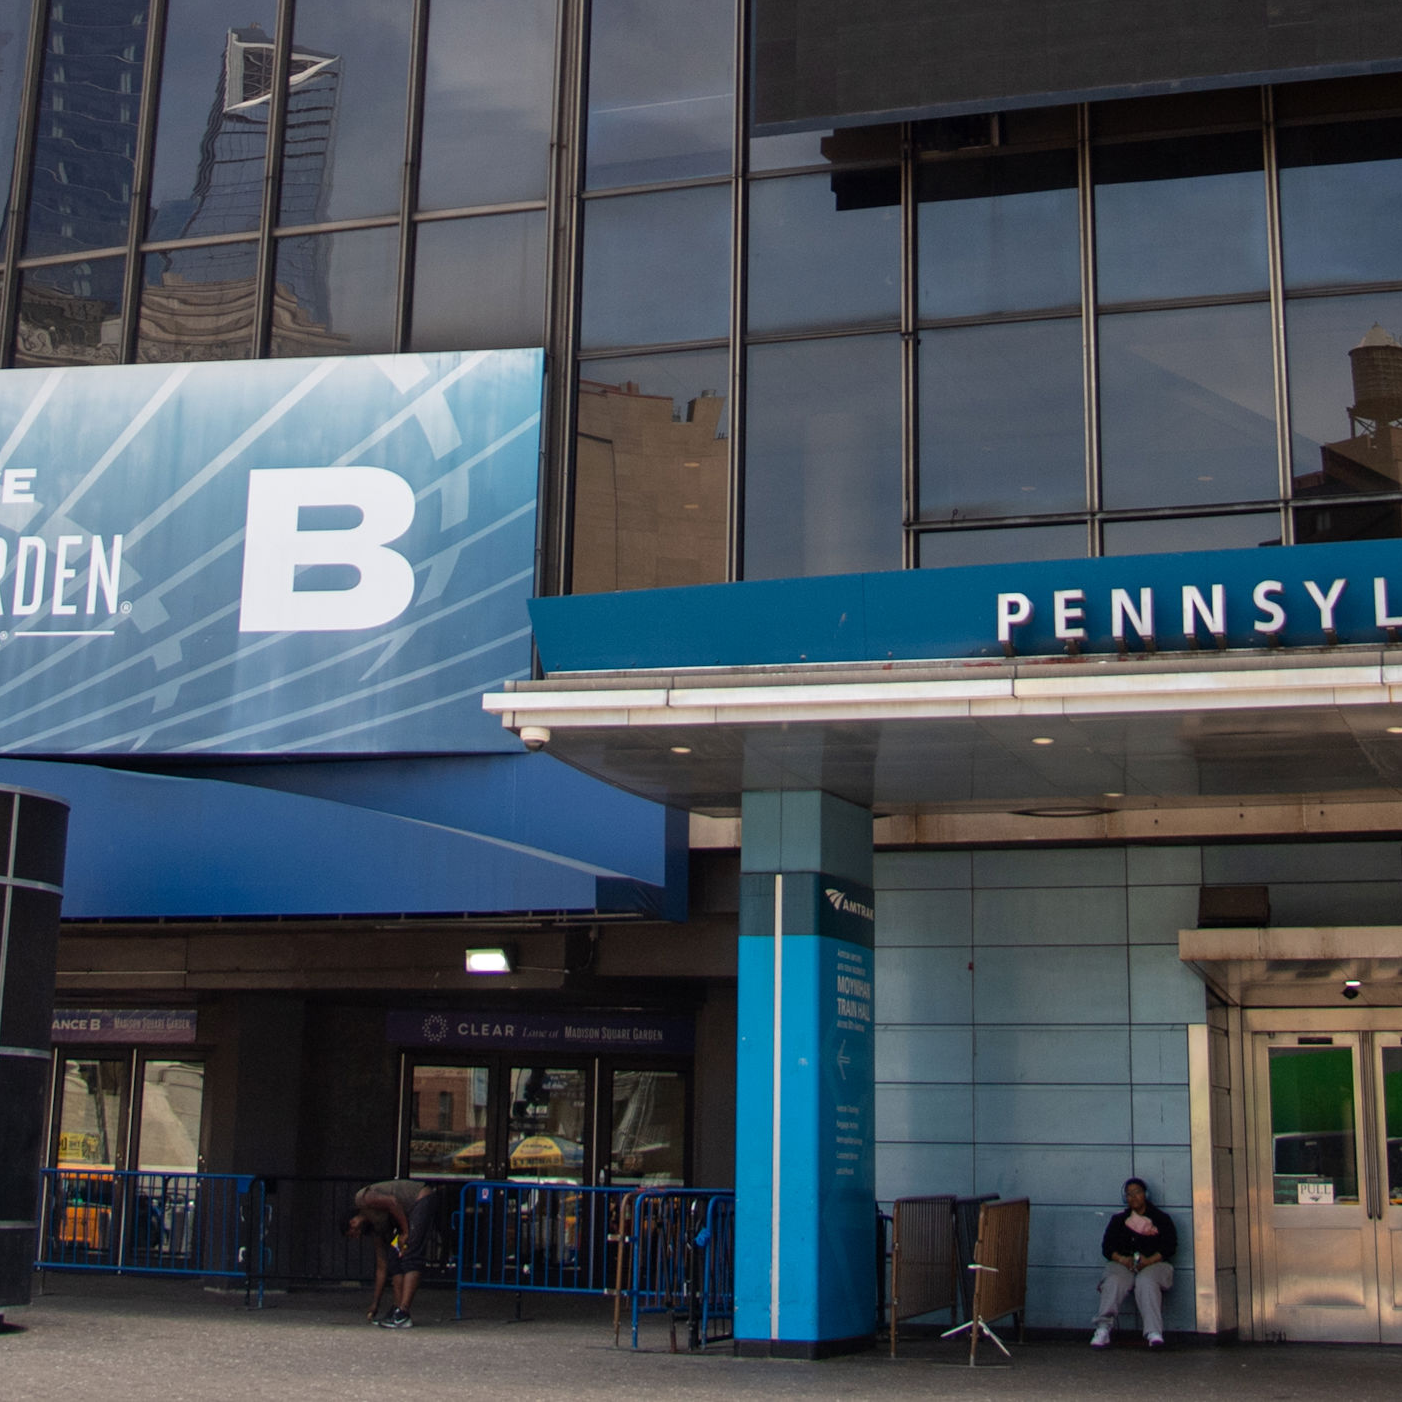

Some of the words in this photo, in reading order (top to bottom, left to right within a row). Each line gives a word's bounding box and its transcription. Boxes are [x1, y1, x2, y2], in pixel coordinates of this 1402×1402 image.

[238, 465, 416, 632] B
[842, 898, 875, 921] AMTRAK
[89, 1018, 101, 1031] B
[457, 1022, 515, 1037] CLEAR
[564, 1024, 600, 1040] MADISON
[601, 1025, 631, 1041] SQUARE
[632, 1026, 663, 1041] GARDEN
[1300, 1184, 1332, 1195] PULL
